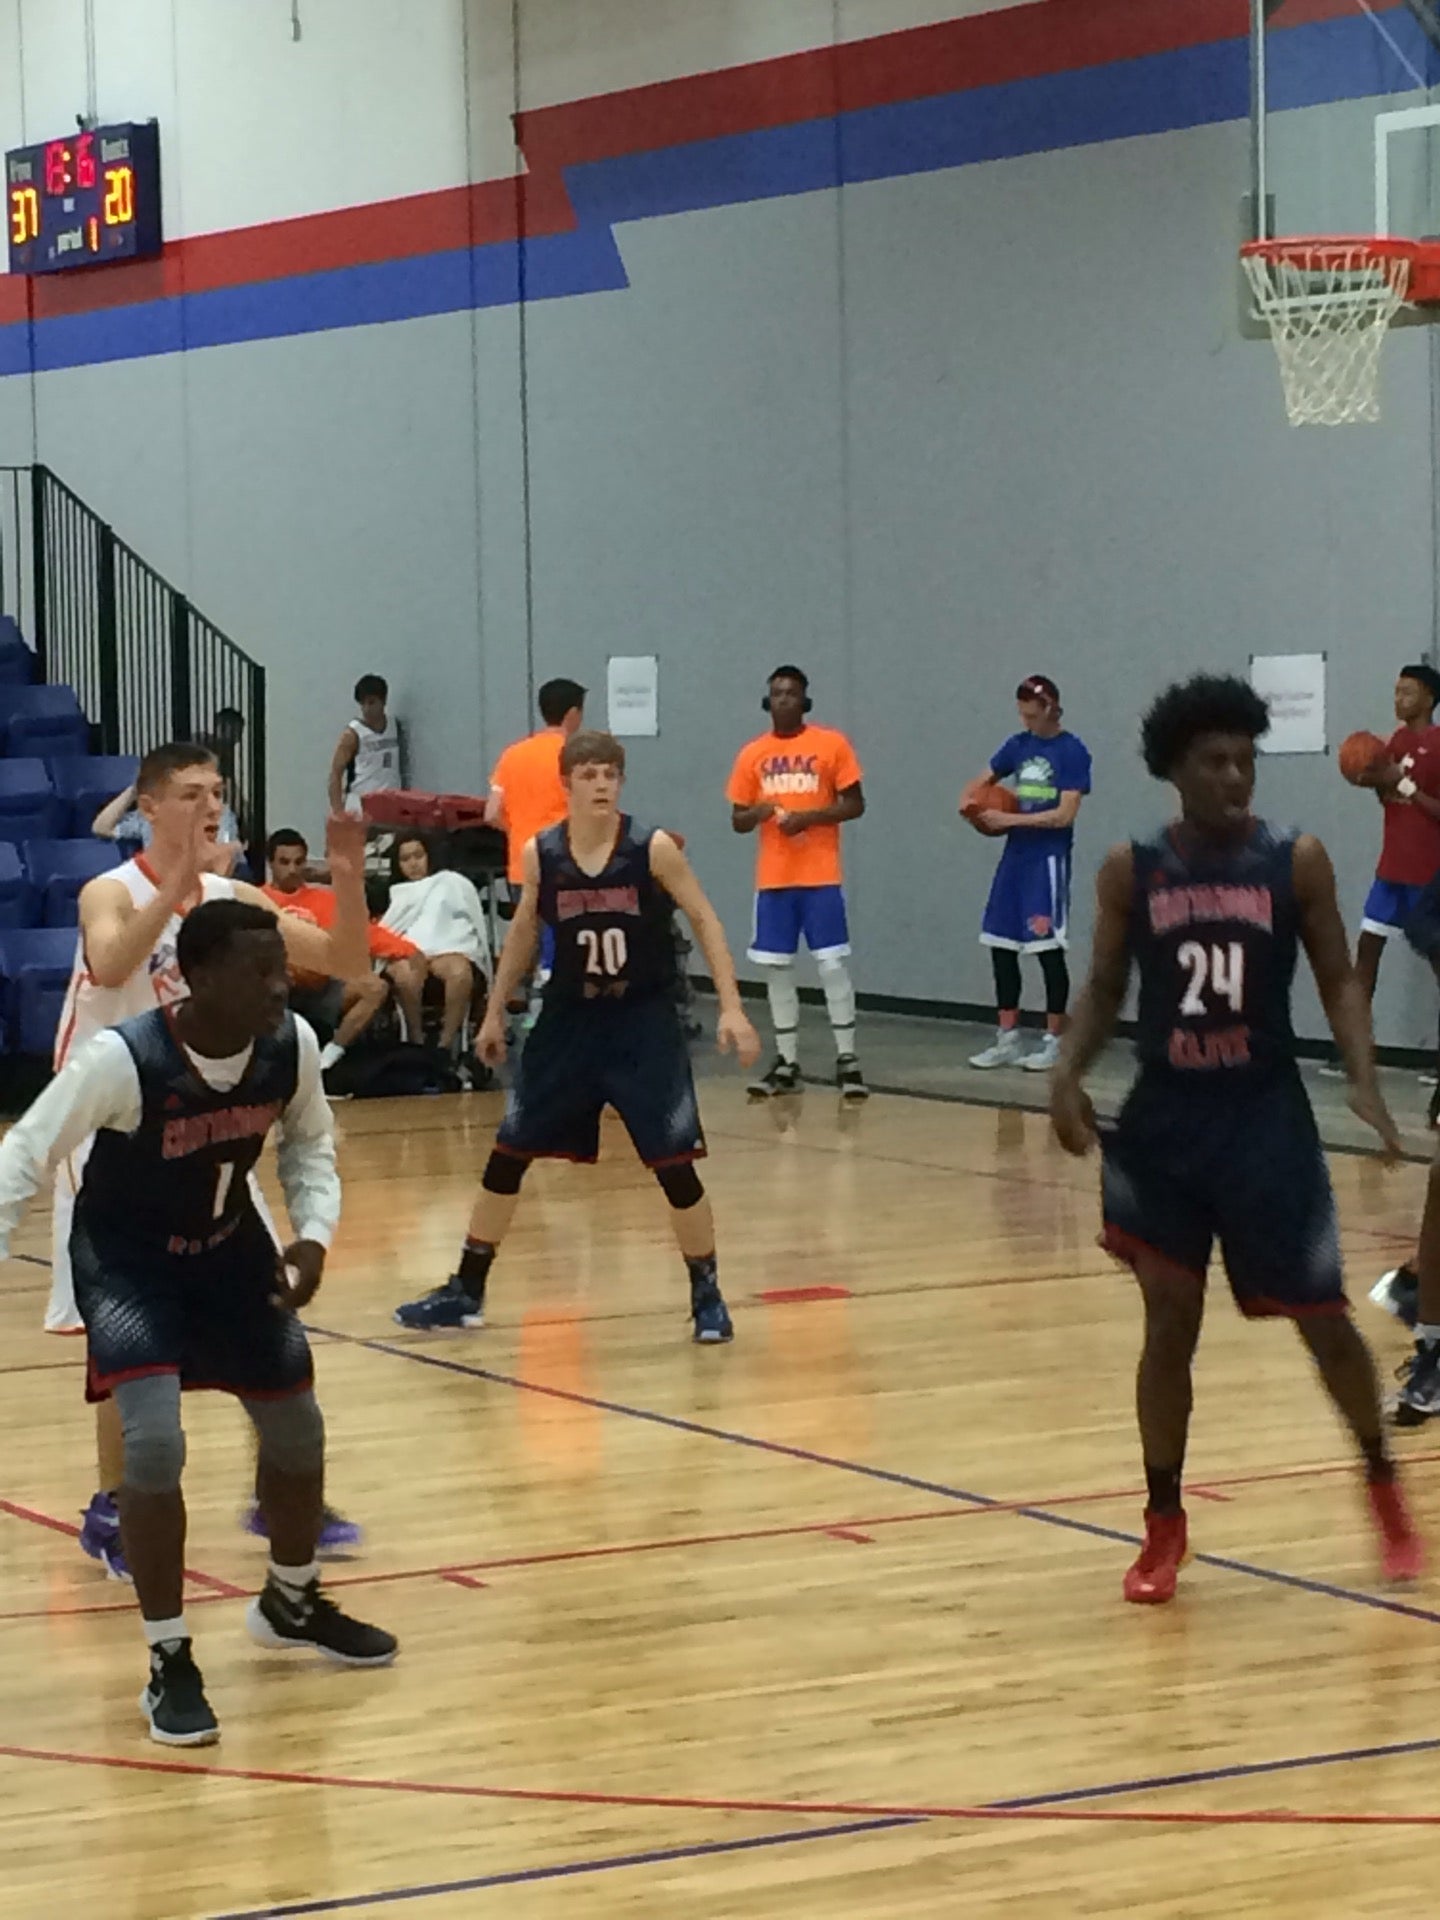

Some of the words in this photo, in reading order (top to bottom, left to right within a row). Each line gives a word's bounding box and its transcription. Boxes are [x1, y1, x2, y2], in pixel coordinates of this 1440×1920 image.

[11, 187, 38, 244] 37
[104, 166, 133, 225] 20
[89, 216, 99, 252] 1
[576, 927, 628, 976] 20
[1176, 940, 1245, 1016] 24
[212, 1161, 235, 1220] 1
